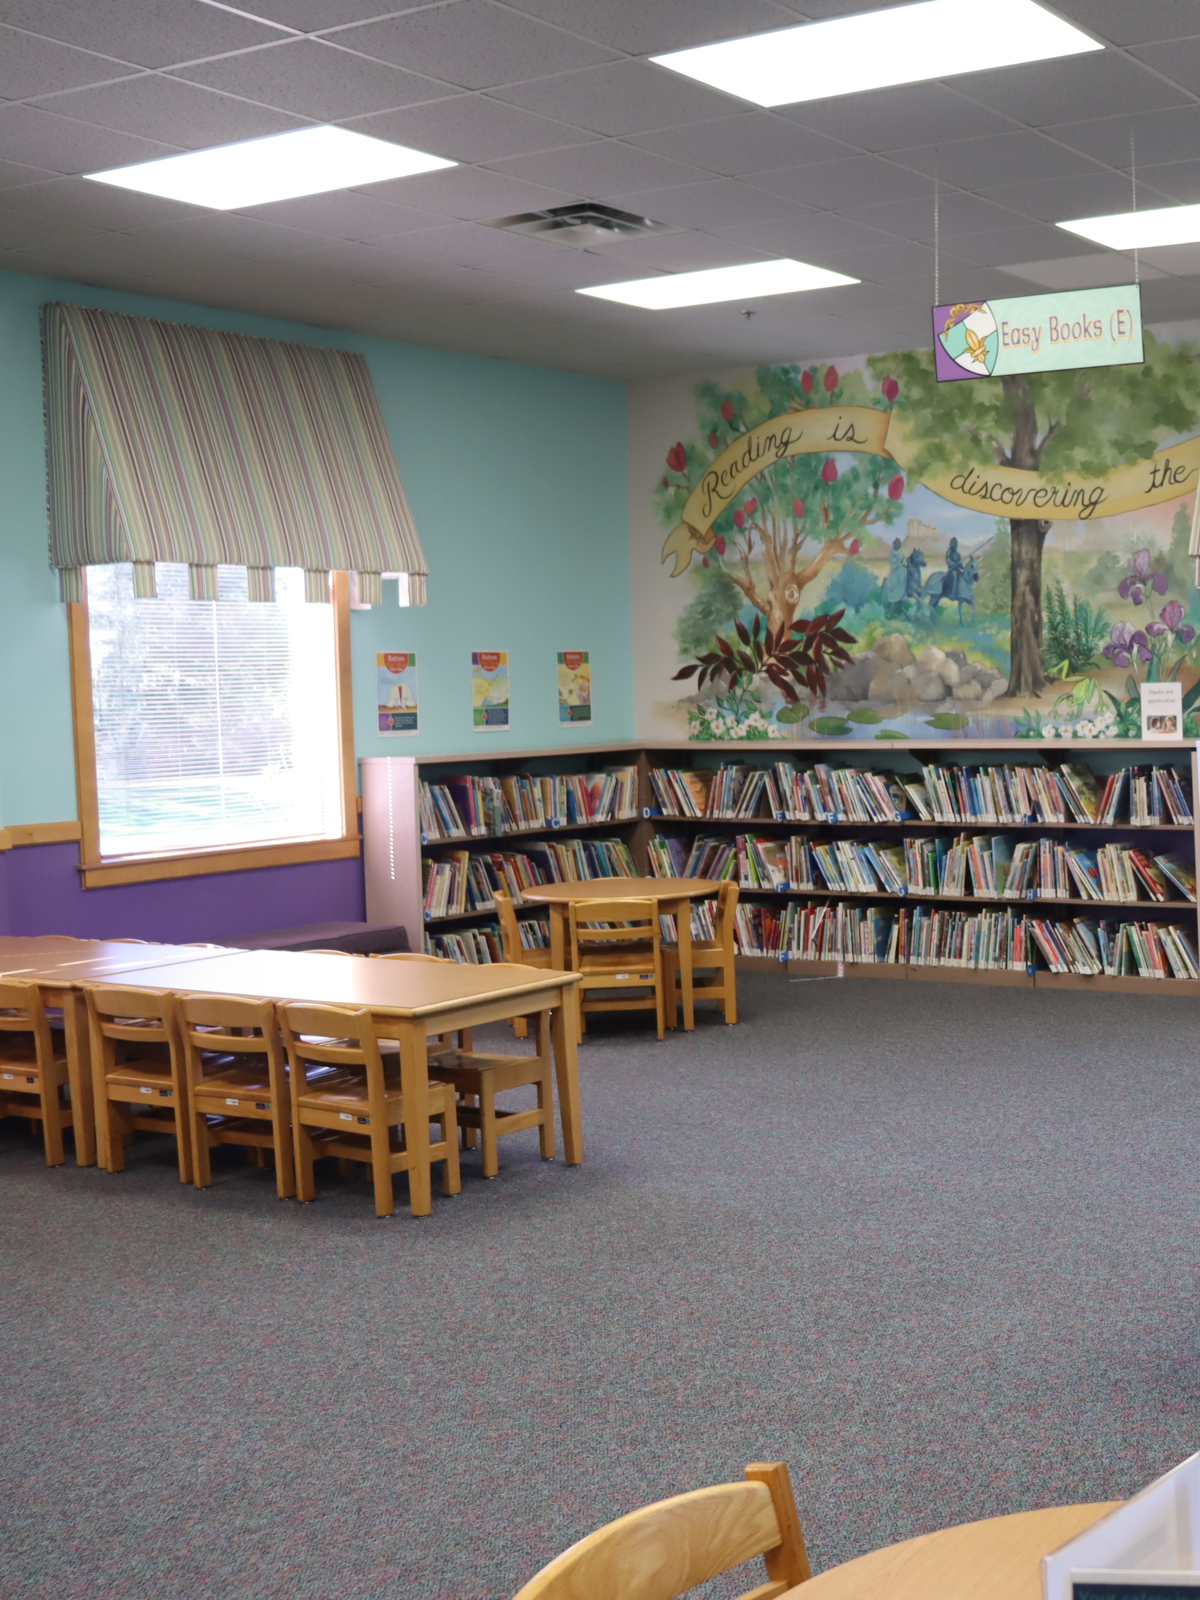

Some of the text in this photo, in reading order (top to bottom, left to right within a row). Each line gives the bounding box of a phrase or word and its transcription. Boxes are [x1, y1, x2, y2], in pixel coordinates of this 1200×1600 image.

[1002, 309, 1134, 354] Easy Books (E)
[702, 416, 869, 517] Reading is
[951, 460, 1200, 519] discovering the
